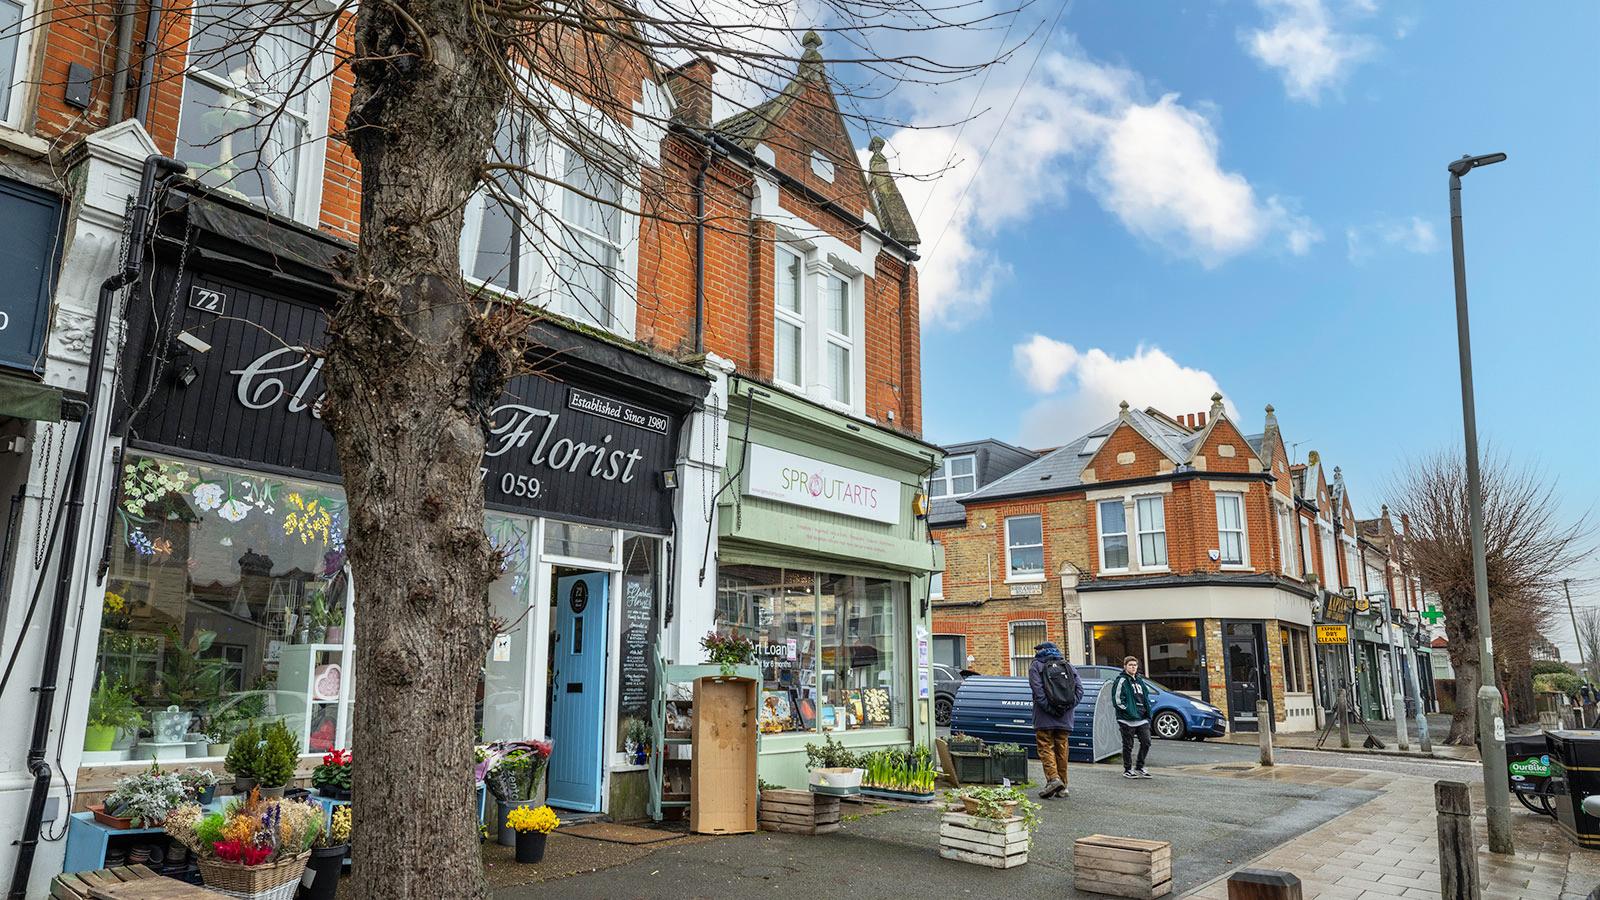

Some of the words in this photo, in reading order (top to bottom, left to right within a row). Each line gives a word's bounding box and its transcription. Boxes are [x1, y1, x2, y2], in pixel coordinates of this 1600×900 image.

[196, 290, 219, 310] 72
[230, 345, 326, 419] Cl
[484, 404, 643, 484] Florist
[571, 393, 622, 418] Established
[623, 408, 646, 425] Since
[647, 415, 667, 431] 1980
[764, 644, 787, 655] Loan
[1512, 763, 1548, 771] OurBike
